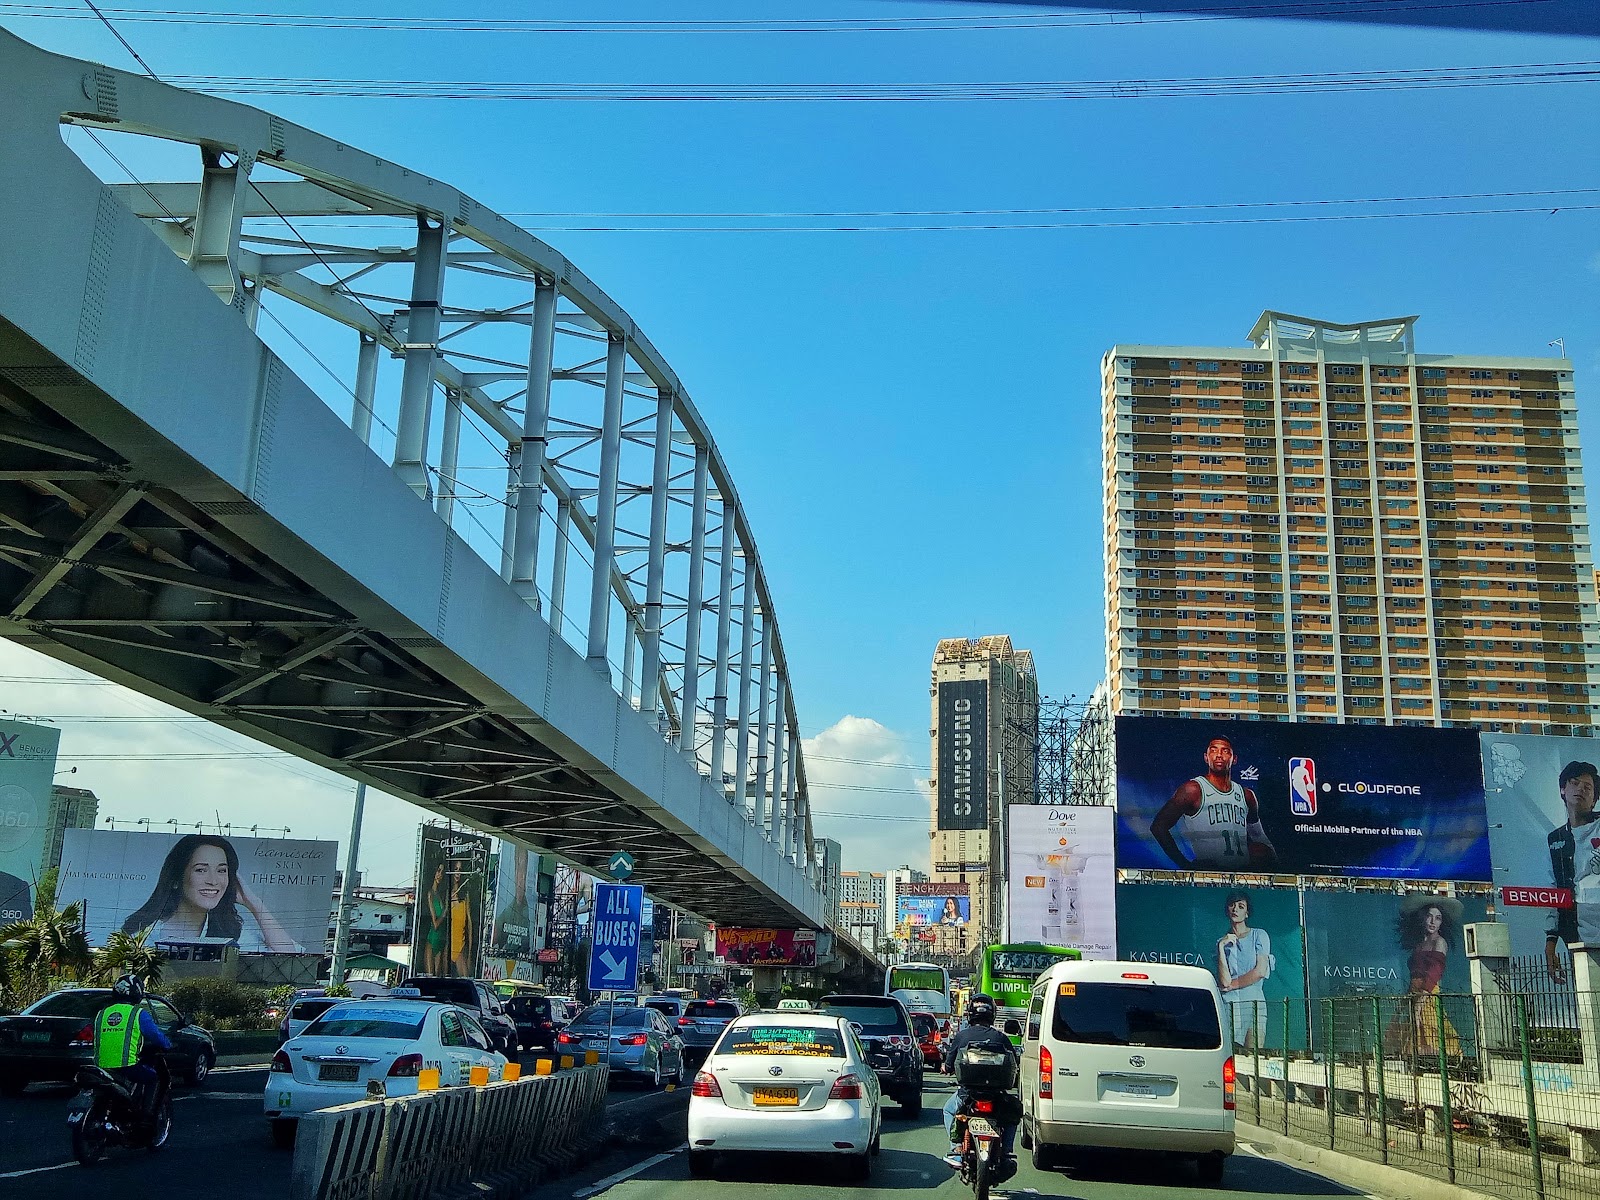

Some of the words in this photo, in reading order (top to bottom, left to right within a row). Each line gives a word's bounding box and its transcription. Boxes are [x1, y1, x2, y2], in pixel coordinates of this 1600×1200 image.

[954, 698, 972, 816] SAMSUNG
[1338, 782, 1421, 795] CLOUDFONE
[1294, 801, 1308, 812] NBA
[1048, 809, 1076, 821] Dove
[1207, 803, 1246, 827] CELTICS
[1294, 824, 1322, 833] Official
[1323, 825, 1350, 834] Mobile
[1351, 826, 1380, 835] Partner
[1381, 827, 1390, 836] of
[1391, 828, 1404, 836] the
[1405, 828, 1423, 836] NBA
[1222, 829, 1245, 856] 11
[253, 841, 326, 859] kamiseta
[275, 861, 303, 869] SKIN
[251, 873, 327, 886] THERMLIFT
[606, 889, 630, 915] ALL
[1509, 890, 1566, 903] BENCH/
[1, 910, 22, 919] 360
[595, 920, 637, 947] BUSES
[1129, 951, 1205, 965] KASHIECA
[1323, 966, 1398, 979] KASHIECA
[330, 1173, 369, 1199] MMDA
